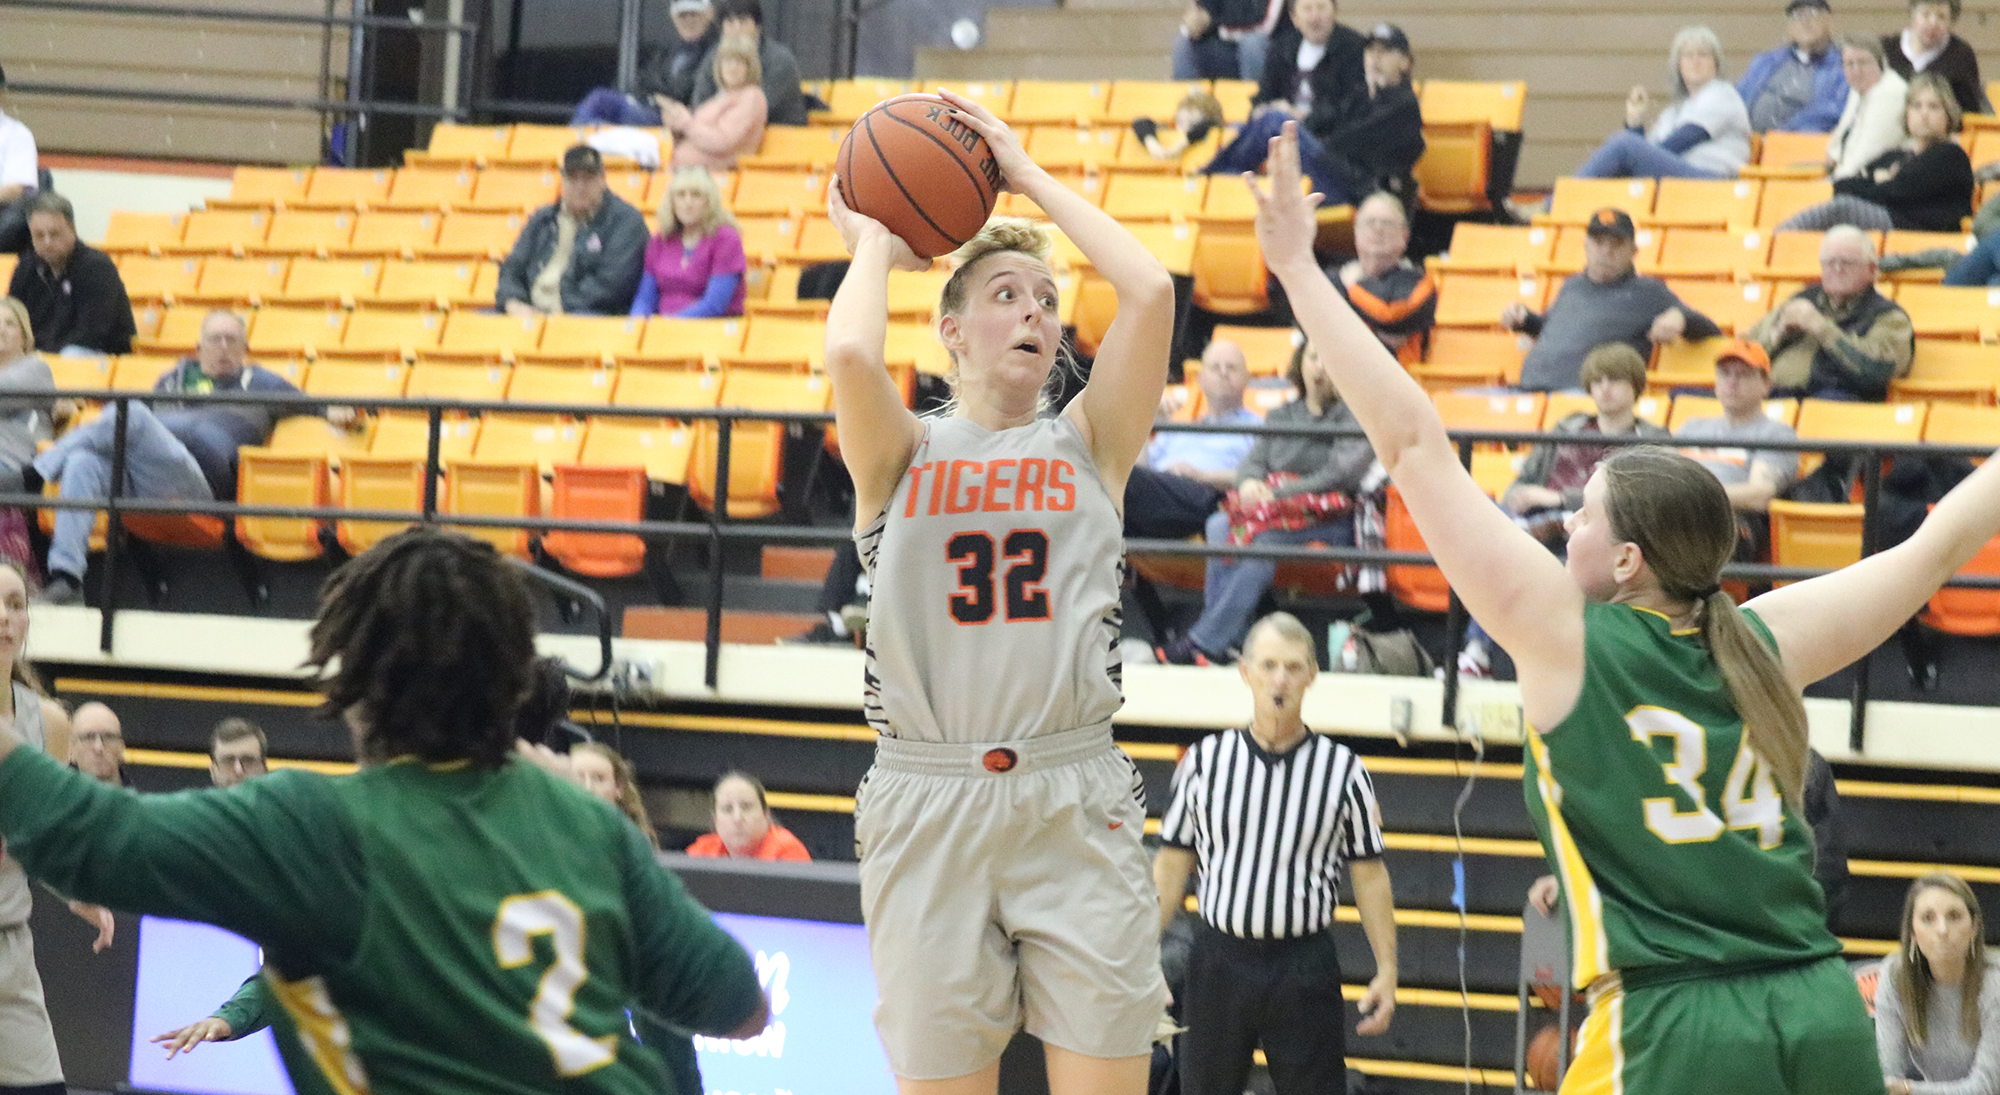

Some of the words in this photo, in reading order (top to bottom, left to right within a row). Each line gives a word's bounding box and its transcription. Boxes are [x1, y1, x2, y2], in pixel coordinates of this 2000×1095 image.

[903, 457, 1076, 518] TIGERS
[945, 528, 1052, 626] 32
[1623, 704, 1786, 850] 34
[493, 889, 617, 1076] 2
